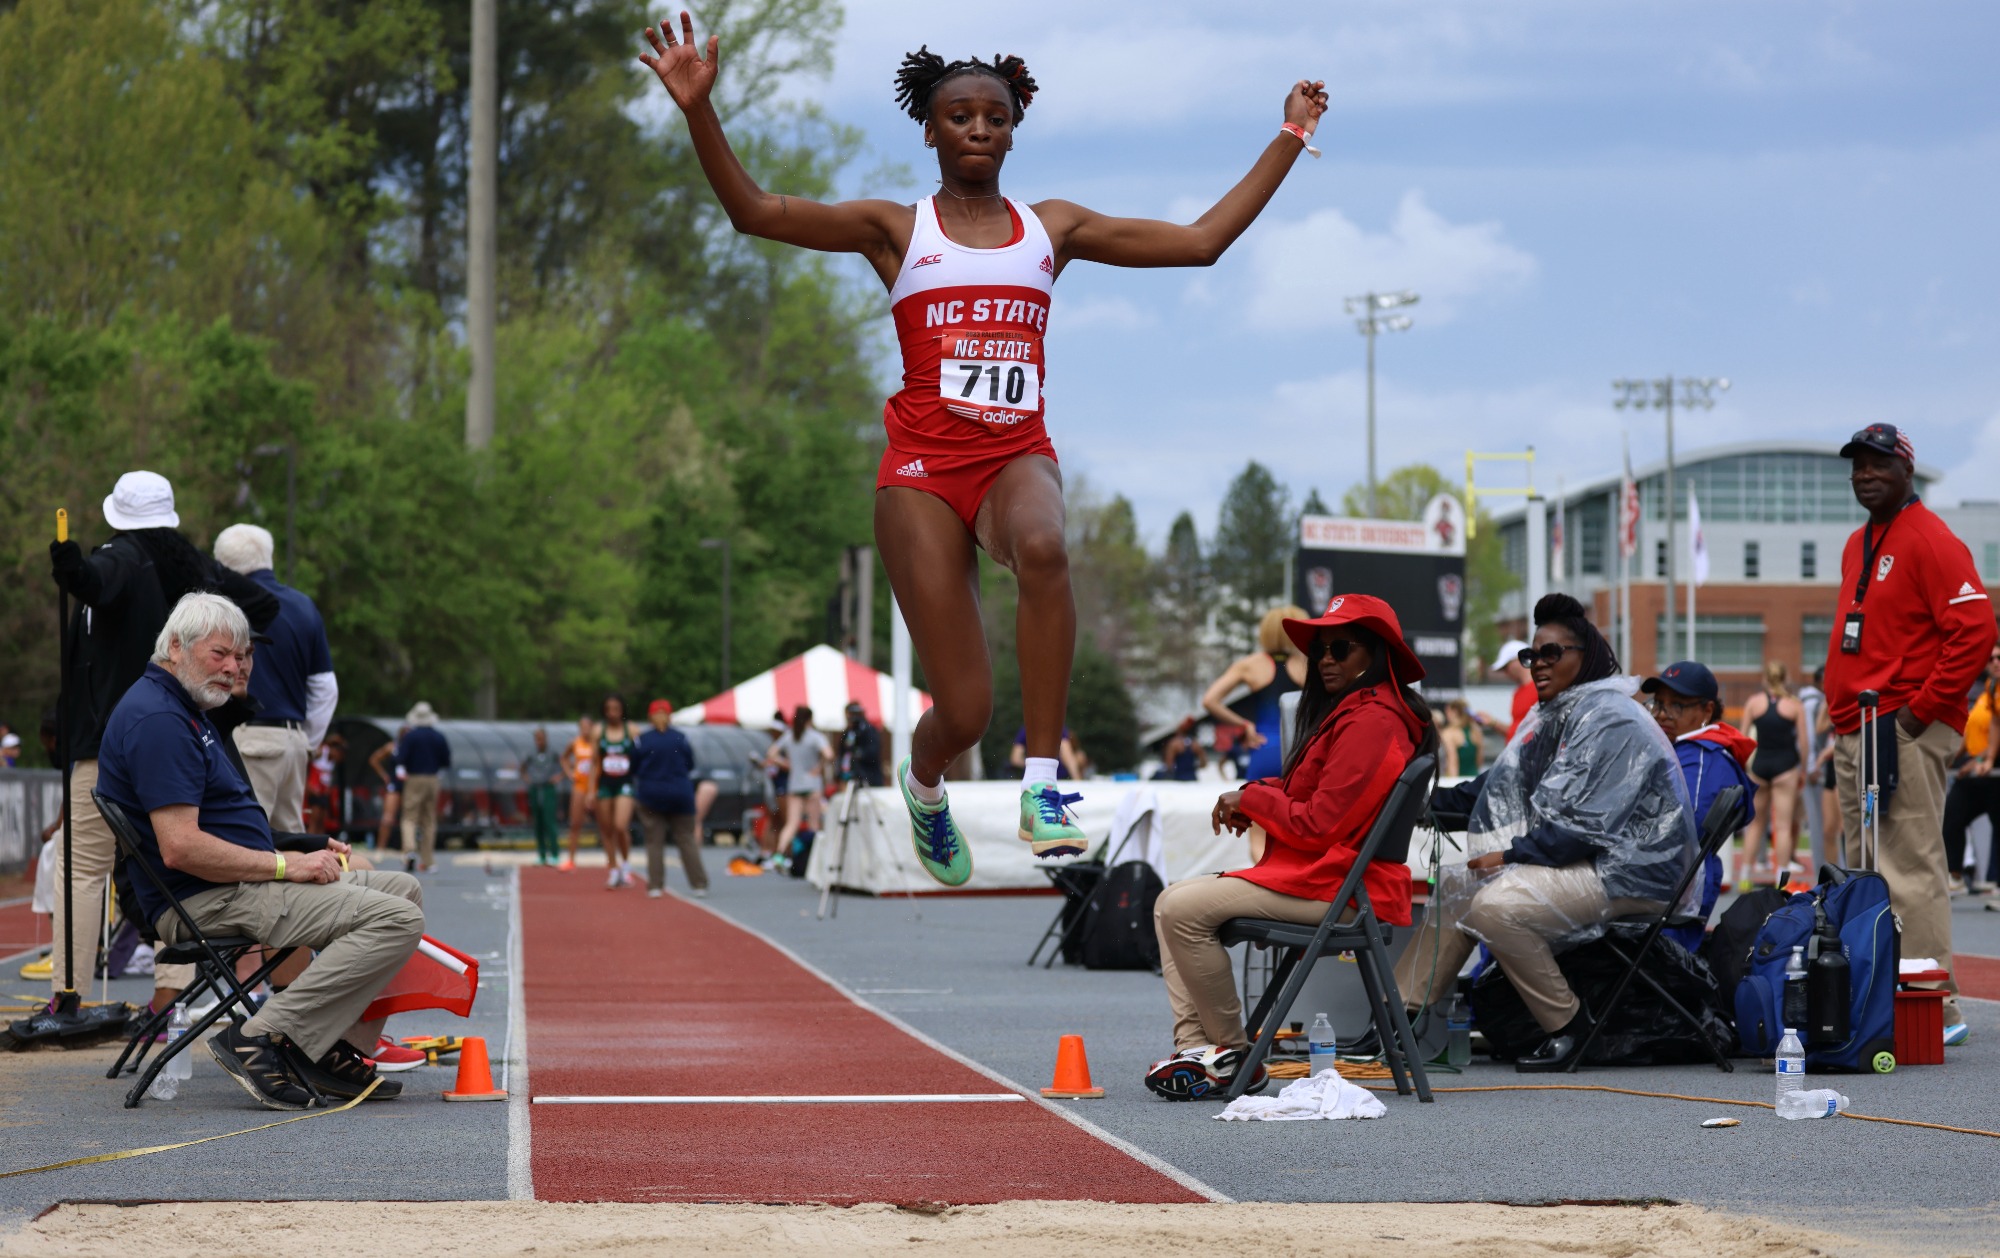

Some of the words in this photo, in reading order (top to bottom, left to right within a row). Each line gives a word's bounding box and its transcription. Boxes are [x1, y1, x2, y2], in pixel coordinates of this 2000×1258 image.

[914, 253, 943, 267] ACC
[926, 299, 965, 328] NC
[972, 298, 1046, 331] STATE
[981, 331, 1004, 339] RALEIGH
[954, 339, 980, 358] NC
[983, 340, 1032, 360] STATE
[959, 364, 1025, 404] 710
[983, 410, 1029, 425] adida
[896, 468, 929, 478] adidas
[1323, 523, 1357, 542] STATE
[1360, 525, 1426, 545] UNIVERSITY
